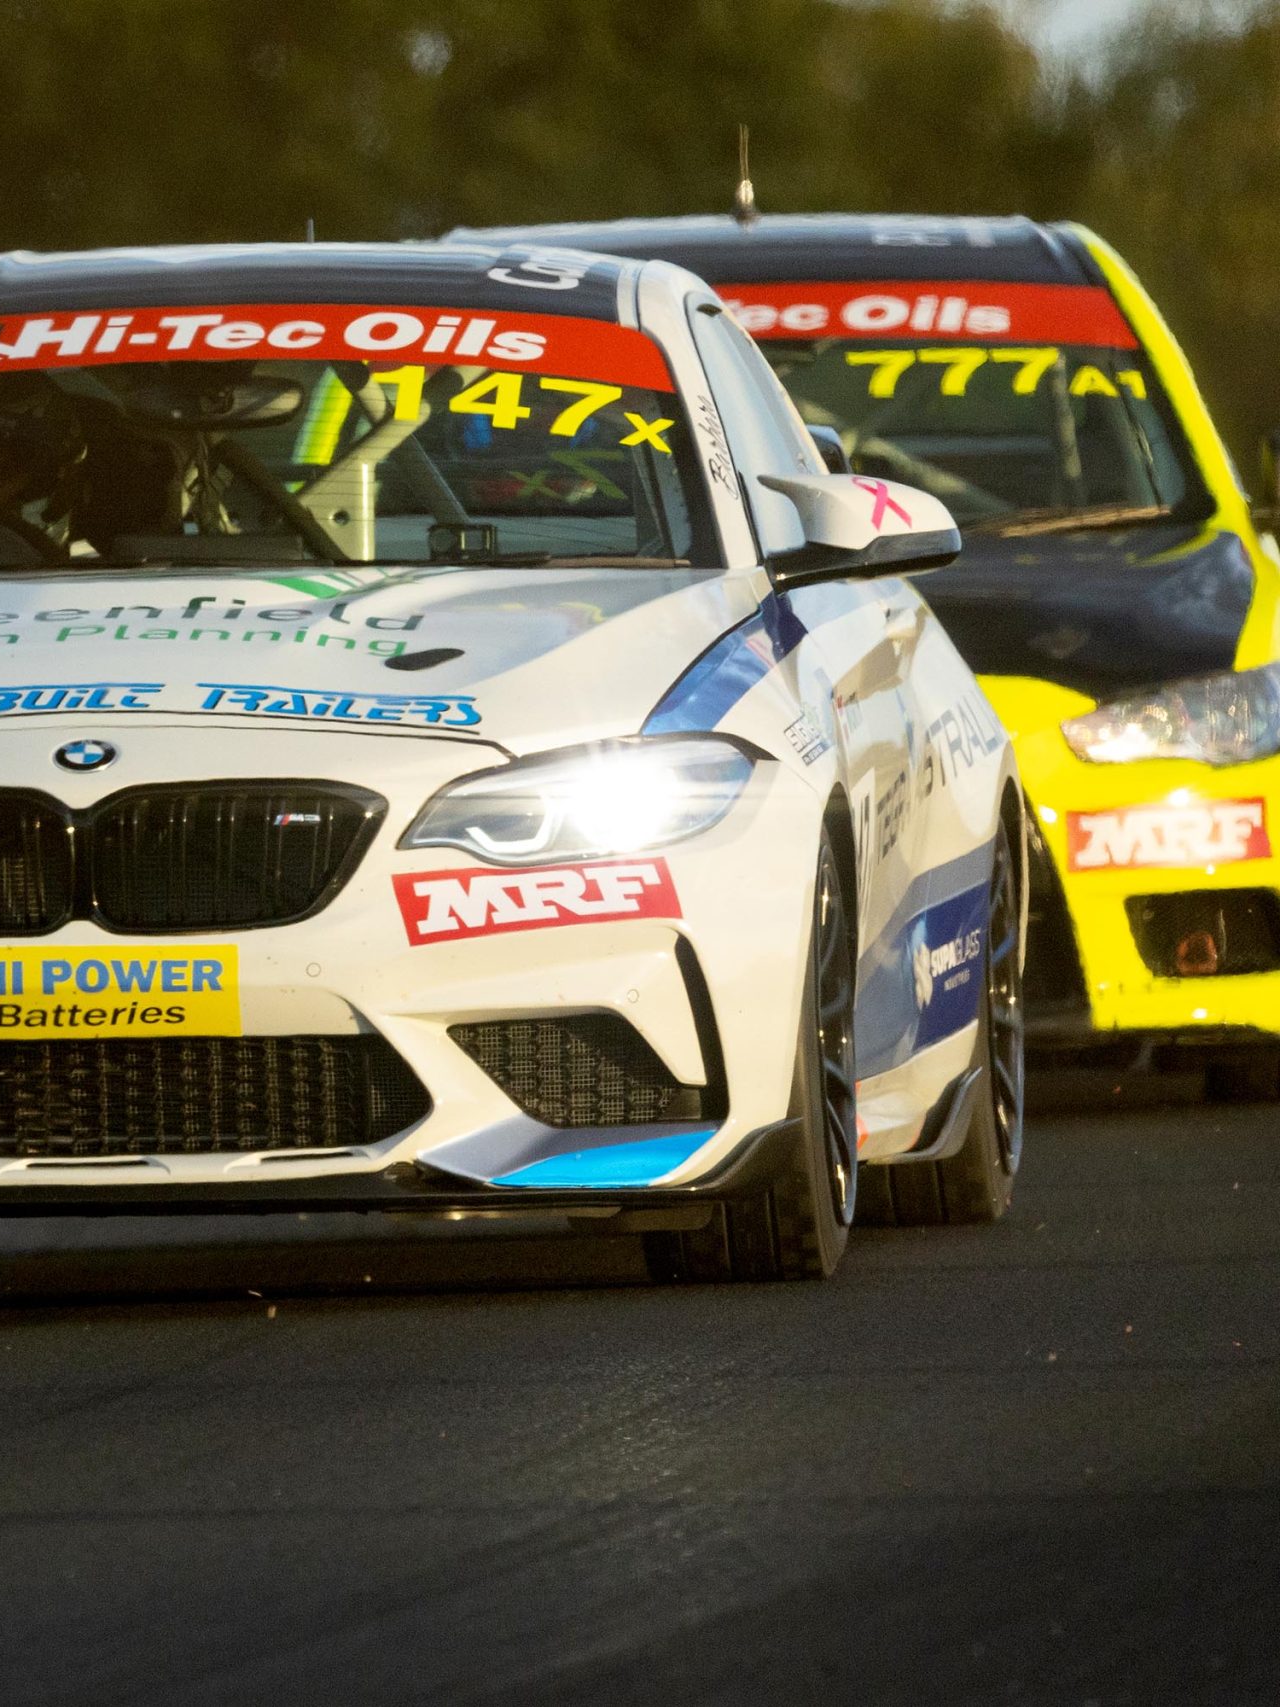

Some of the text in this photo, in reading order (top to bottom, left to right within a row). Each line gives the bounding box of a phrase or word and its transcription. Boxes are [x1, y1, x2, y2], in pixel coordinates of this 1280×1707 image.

[17, 312, 548, 361] Hi-Tec Oils
[841, 295, 1011, 334] Oils
[845, 347, 1147, 400] 777 A1
[371, 364, 622, 437] 147
[56, 624, 408, 658] Planning
[1074, 803, 1263, 868] MRF
[413, 863, 662, 936] MRF
[41, 959, 224, 996] POWER
